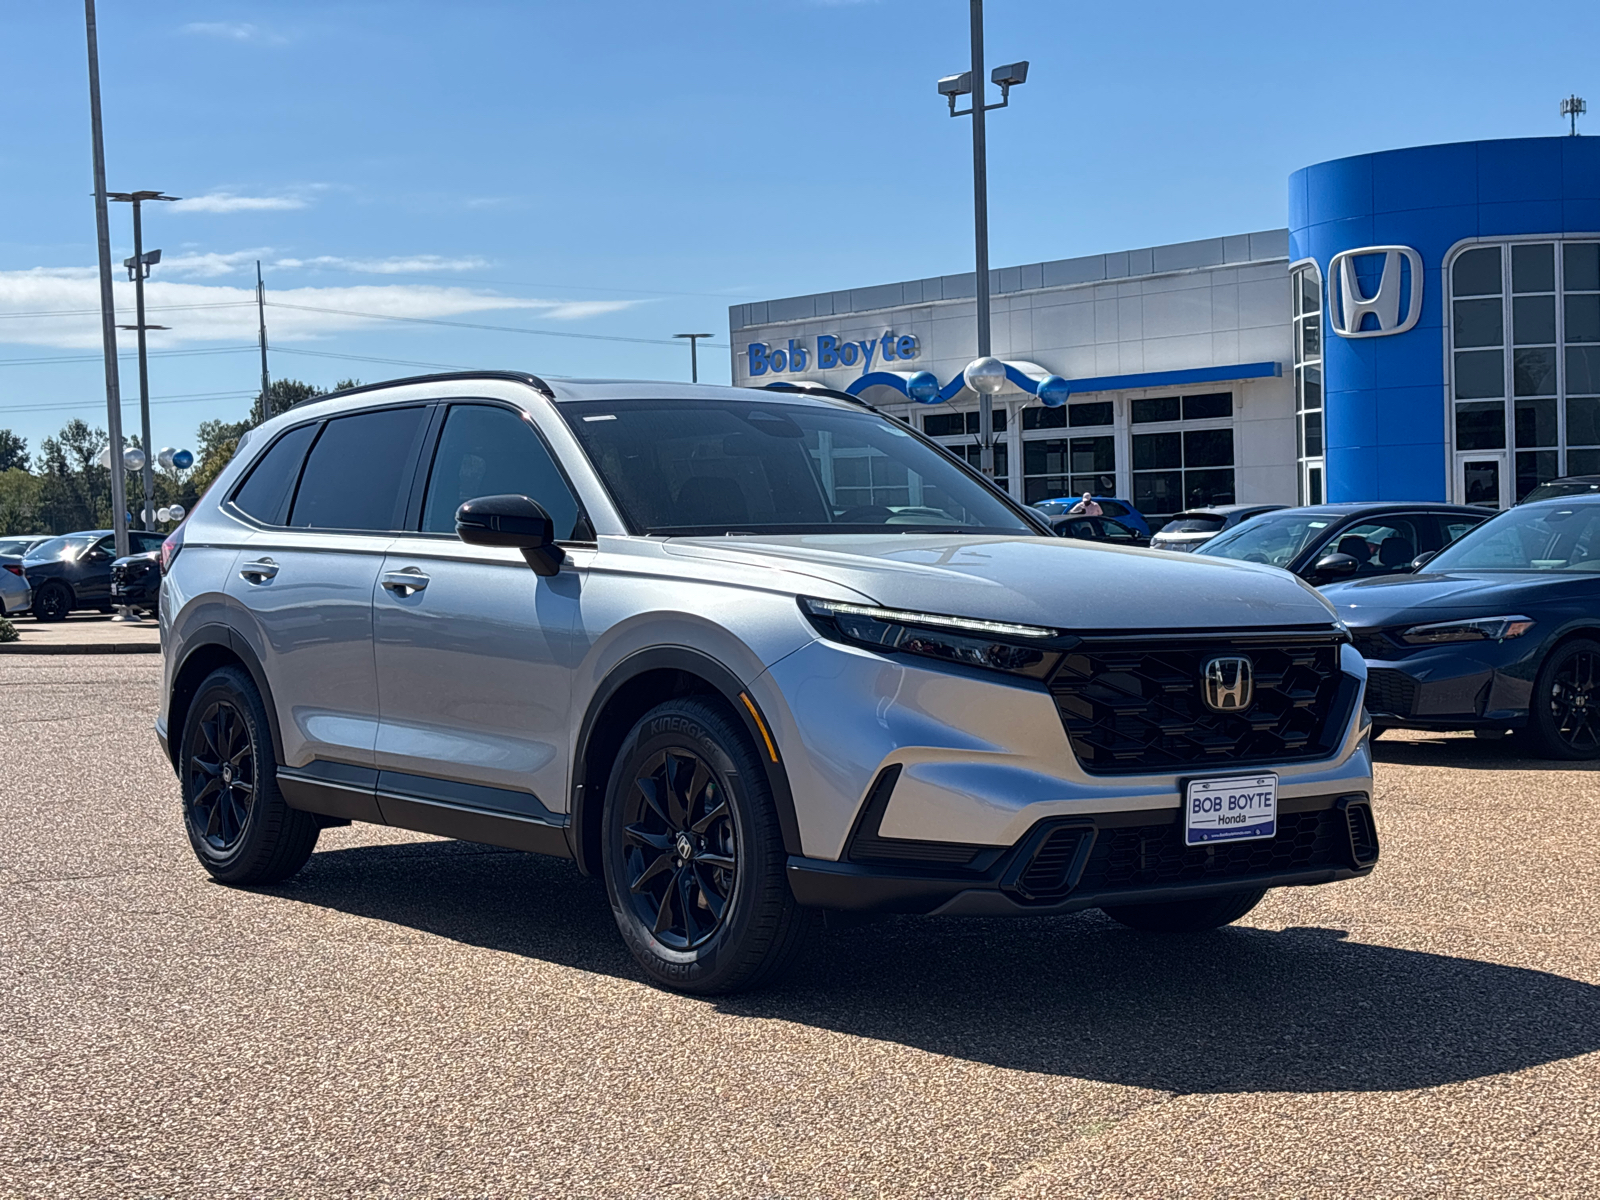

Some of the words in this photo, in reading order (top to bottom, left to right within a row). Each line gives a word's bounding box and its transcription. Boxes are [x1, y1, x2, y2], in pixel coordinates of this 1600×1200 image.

[748, 339, 808, 376] Bob
[817, 330, 917, 375] Boyte
[1192, 797, 1223, 814] BOB
[1228, 792, 1273, 811] BOYTE
[1217, 813, 1247, 826] Honda
